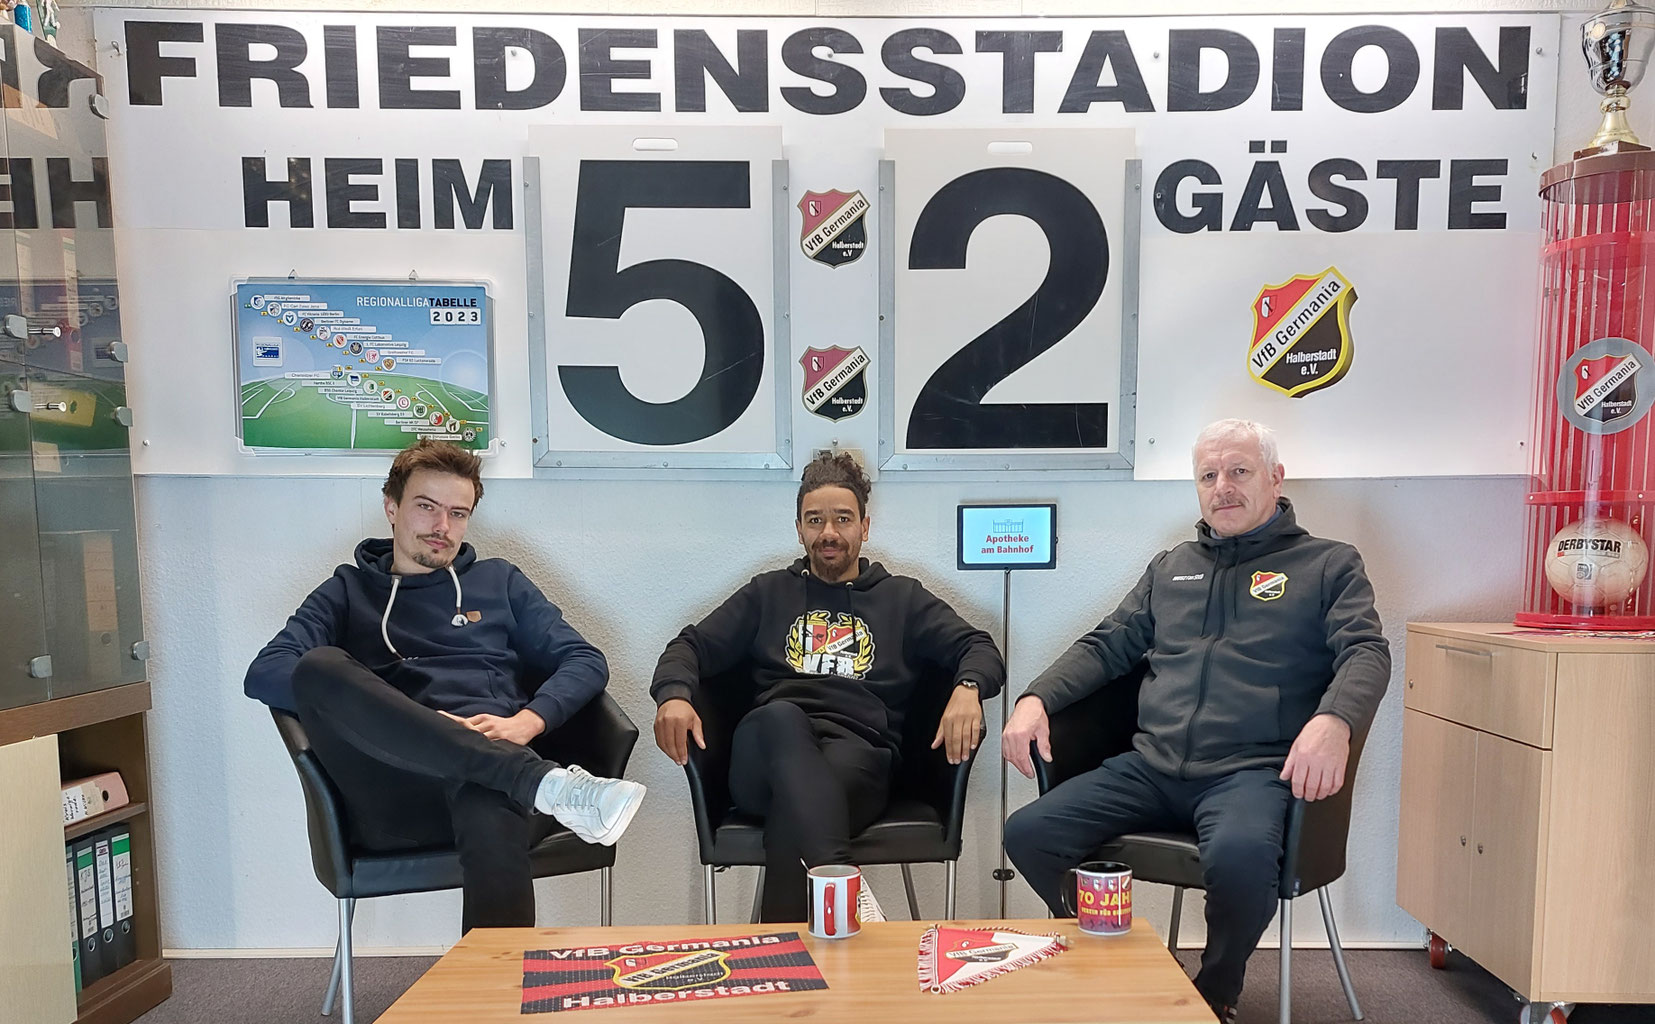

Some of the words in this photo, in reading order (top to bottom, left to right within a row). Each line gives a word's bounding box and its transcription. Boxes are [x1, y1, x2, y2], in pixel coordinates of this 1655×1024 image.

[125, 21, 1531, 115] FRIEDENSSTADION
[242, 157, 513, 230] HEIM
[1154, 140, 1508, 233] GÄSTE
[805, 236, 824, 252] VfB
[822, 199, 865, 237] Germania
[832, 240, 864, 249] Halberstadt
[356, 296, 477, 307] REGIONALLIGATABELLE
[558, 160, 764, 446] 5
[907, 166, 1110, 449] 2
[432, 311, 479, 322] 2023
[1252, 342, 1277, 369] VfB
[1275, 280, 1341, 345] Germania
[1286, 348, 1337, 364] Halberstadt
[806, 391, 825, 406] VfB
[823, 354, 866, 392] Germania
[1301, 363, 1319, 375] e.V.
[1577, 394, 1595, 410] VfB
[1593, 360, 1636, 397] Germania
[832, 397, 863, 405] Halberstadt
[986, 534, 1029, 544] Apotheke
[997, 545, 1034, 553] Bahnhof
[1557, 538, 1621, 553] DERBYSTAR
[837, 631, 864, 647] Germaia
[1079, 889, 1094, 905] 70
[550, 947, 610, 959] VfB
[619, 935, 780, 954] Germania
[623, 972, 651, 983] VfB
[651, 952, 721, 974] Germania
[563, 979, 791, 1009] Halberstadt
